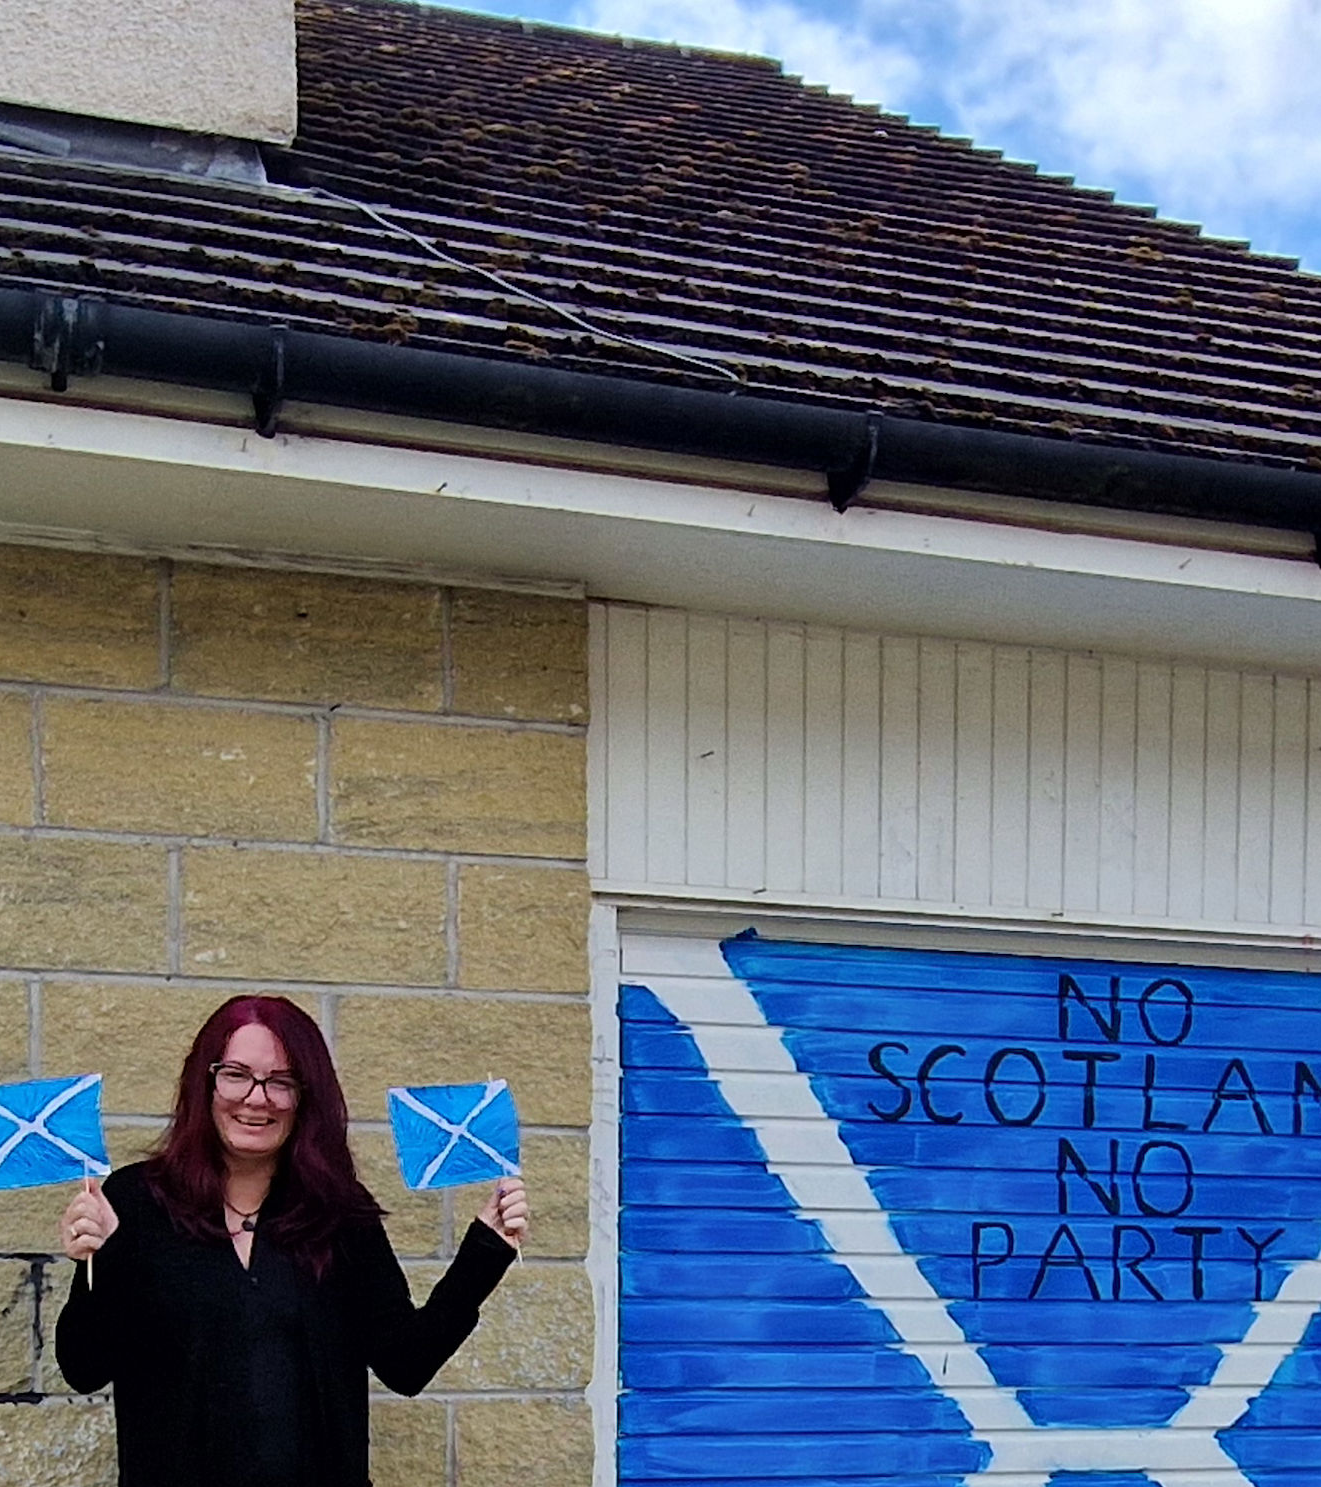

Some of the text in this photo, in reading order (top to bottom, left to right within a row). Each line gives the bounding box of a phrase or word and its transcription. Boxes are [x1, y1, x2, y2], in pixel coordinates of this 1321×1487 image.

[1057, 973, 1194, 1046] NO
[1057, 1137, 1194, 1217] NO
[971, 1221, 1286, 1301] PARTY
